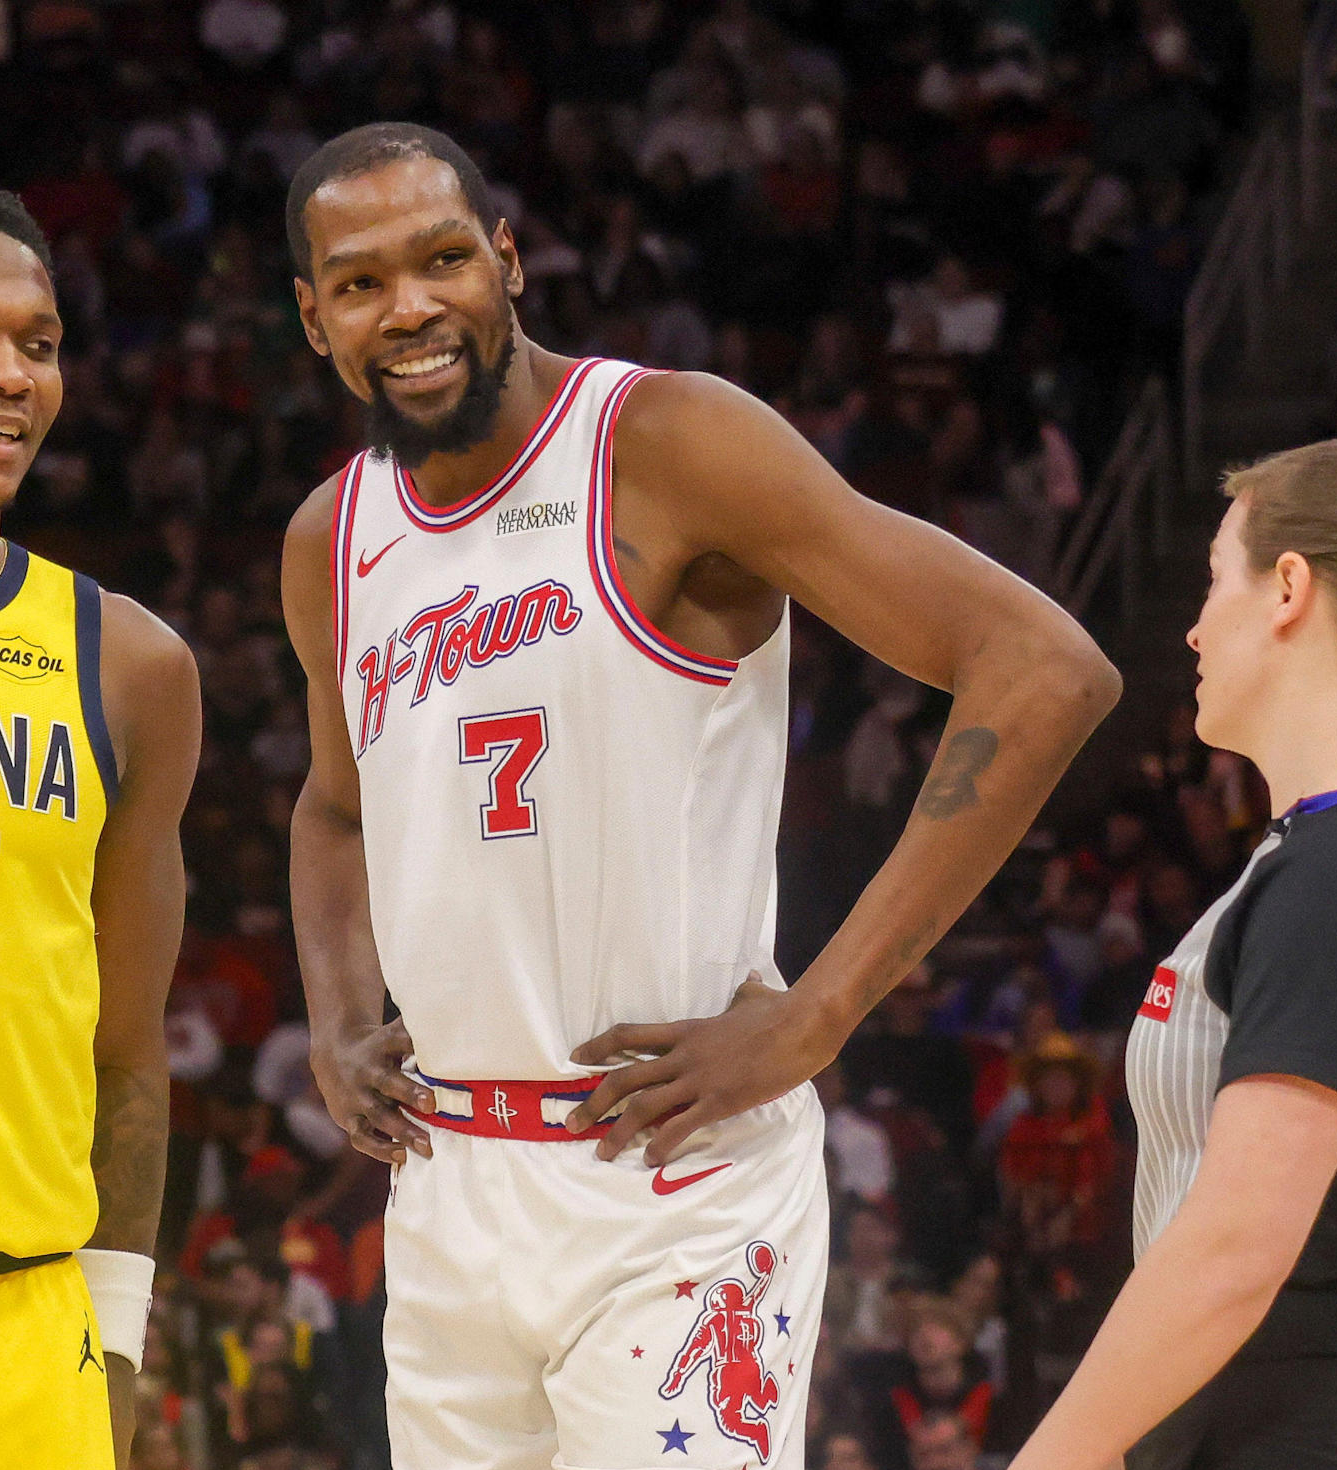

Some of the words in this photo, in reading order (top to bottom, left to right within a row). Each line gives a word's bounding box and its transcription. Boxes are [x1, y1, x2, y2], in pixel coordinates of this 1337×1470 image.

[496, 500, 577, 522] MEMORIAL
[496, 512, 576, 536] HERMANN
[37, 655, 65, 672] OIL
[357, 579, 582, 762] H-Town
[457, 705, 550, 841] 7
[1143, 979, 1173, 1009] tes
